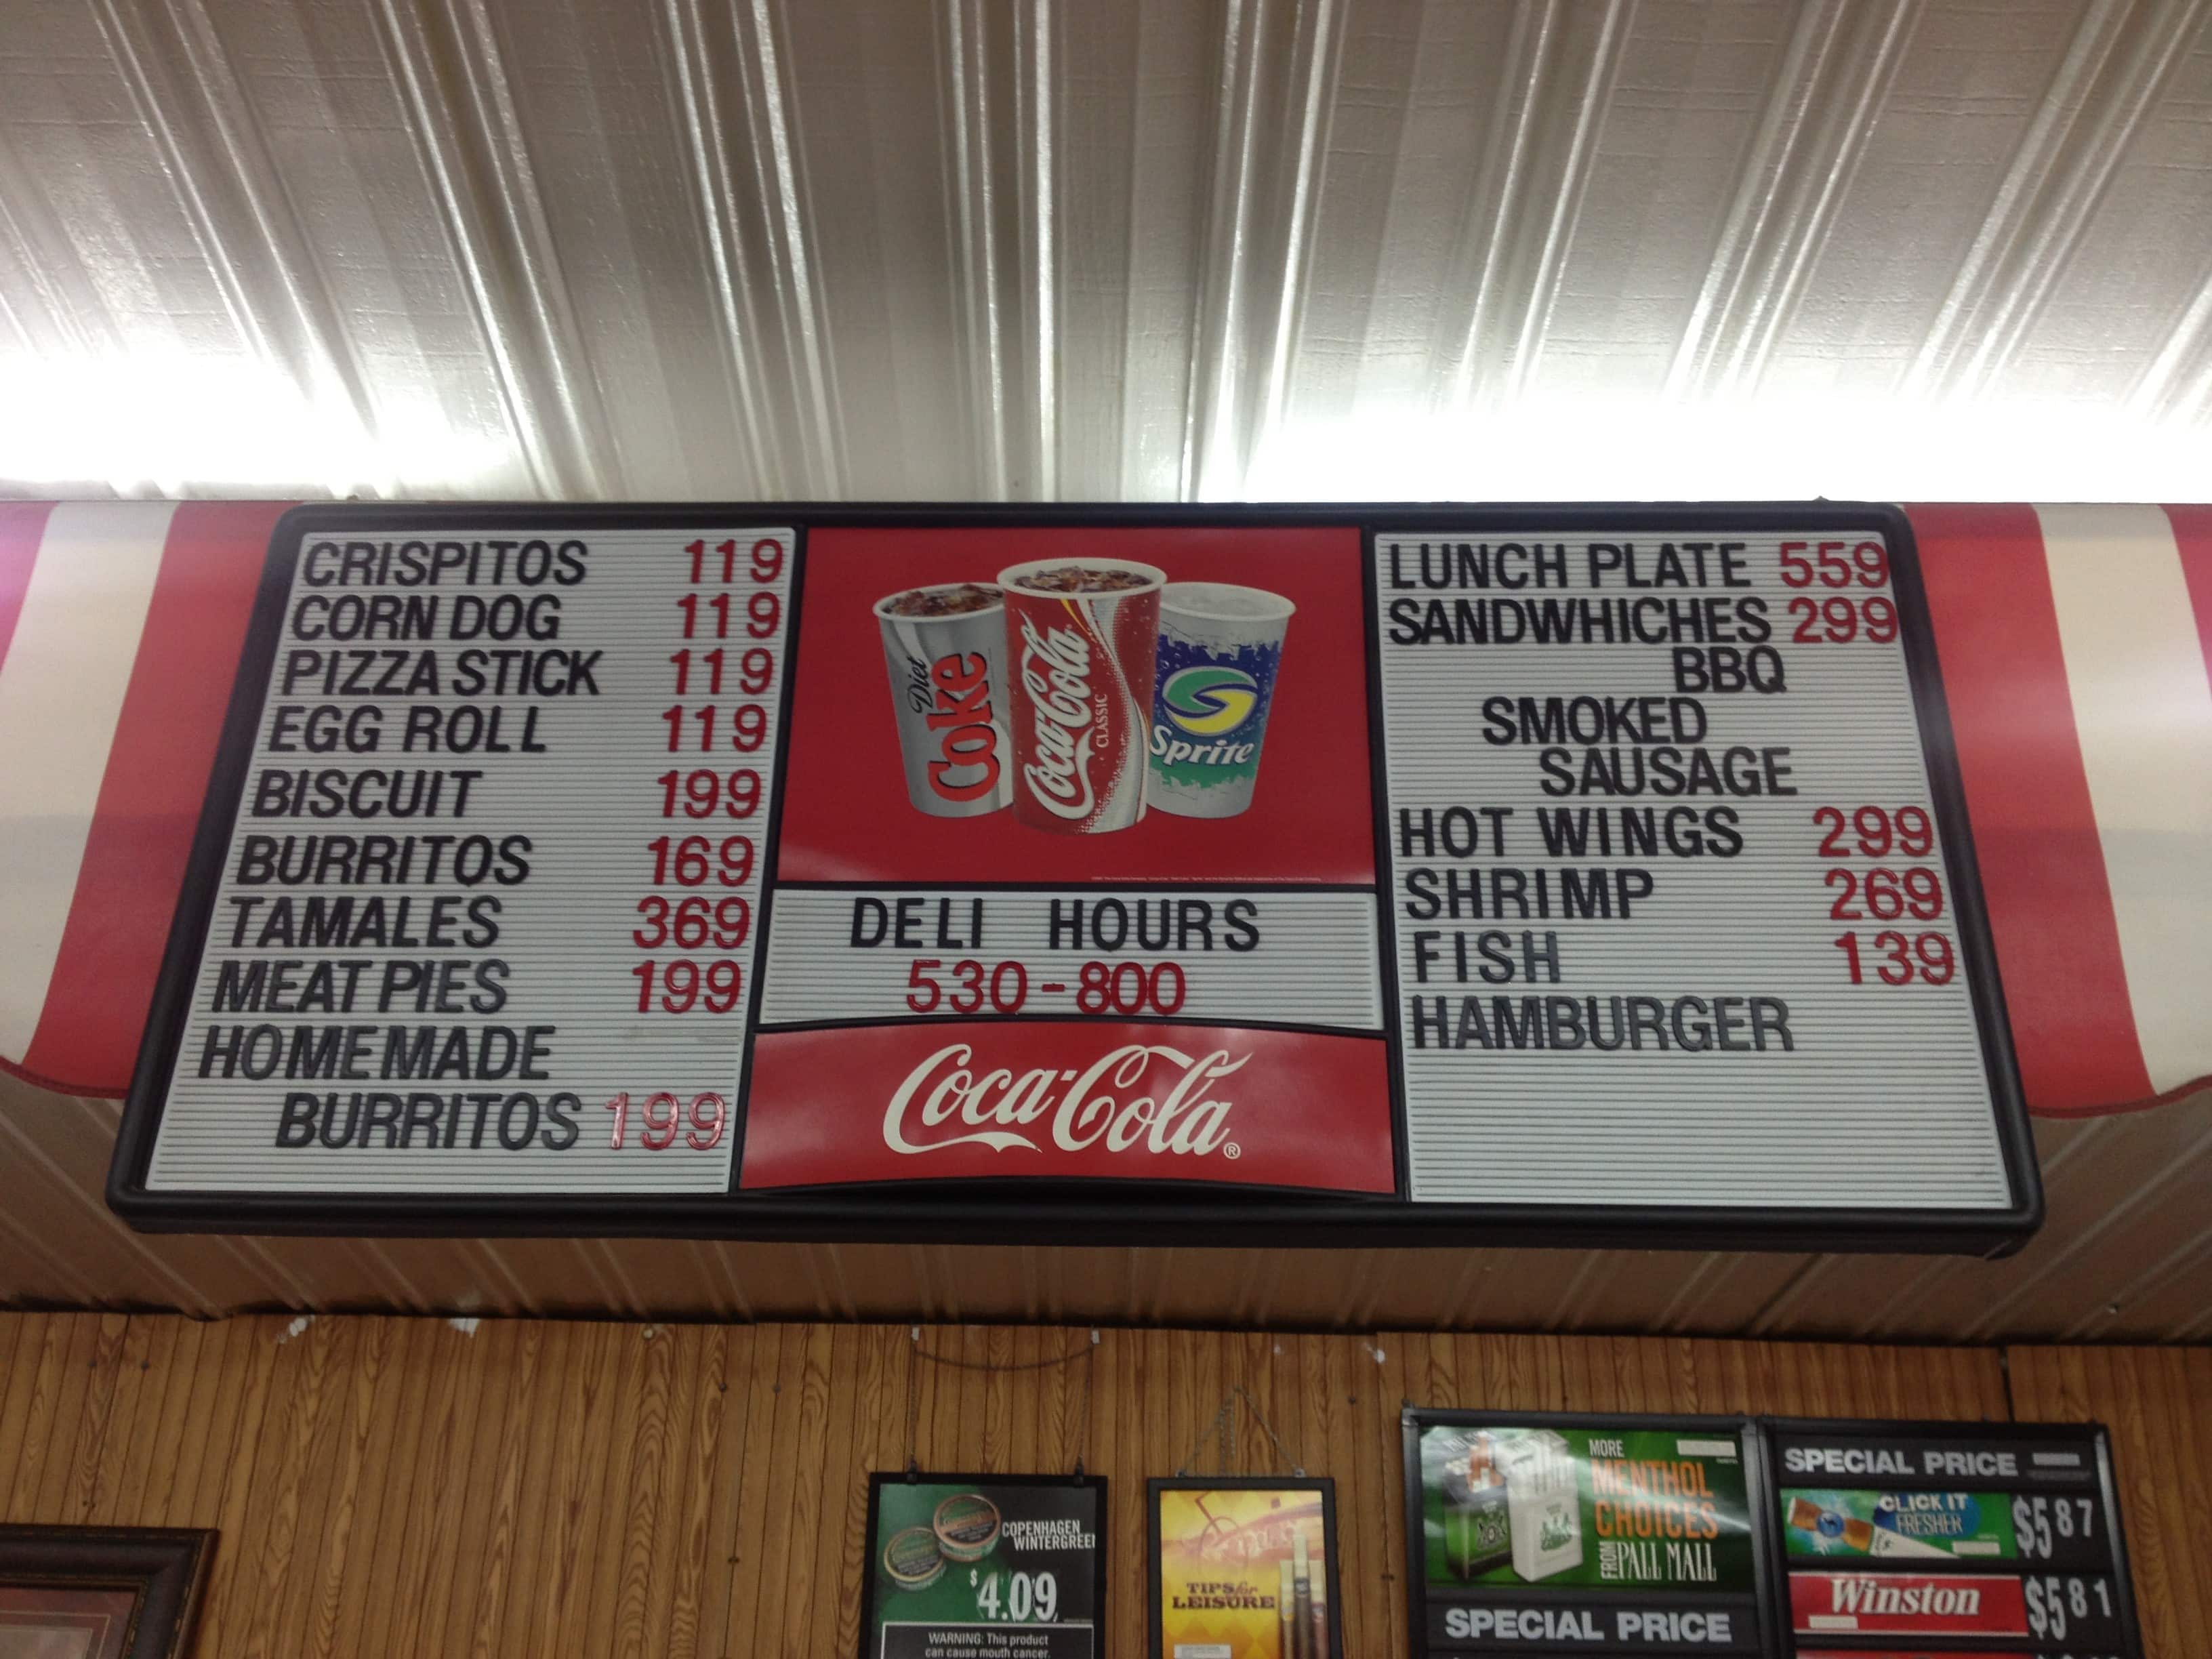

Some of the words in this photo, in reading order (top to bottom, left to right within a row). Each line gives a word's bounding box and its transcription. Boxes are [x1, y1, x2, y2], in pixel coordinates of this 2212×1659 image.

[303, 539, 588, 587] CRISPITOS
[684, 539, 783, 584] 119
[1389, 541, 1568, 590] LUNCH
[1589, 543, 1752, 588] PLATE
[1780, 541, 1889, 588] 559
[292, 594, 438, 640] CORN
[448, 594, 561, 640] DOG
[678, 592, 781, 639] 119
[1388, 596, 1773, 645] SANDWHICHES
[1786, 595, 1898, 644] 299
[281, 649, 439, 696] PIZZA
[452, 649, 602, 696] STICK
[670, 648, 774, 695] 119
[907, 655, 933, 714] Diet
[1673, 645, 1787, 693] BBQ
[269, 704, 382, 753] EGG
[403, 704, 547, 753] ROLL
[662, 704, 767, 752] 119
[925, 651, 1001, 802] Coke
[1018, 609, 1095, 820] Coca-Cola
[1094, 693, 1109, 748] CLASSIC
[1482, 696, 1708, 746] SMOKED
[1149, 724, 1254, 766] Sprite
[251, 769, 482, 818] BISCUIT
[657, 769, 761, 819] 199
[1539, 746, 1798, 798] SAUSAGE
[1399, 806, 1515, 859] HOT
[1538, 806, 1744, 858] WINGS
[1811, 806, 1934, 858] 299
[235, 835, 533, 887] BURRITOS
[649, 835, 754, 886] 169
[1405, 868, 1654, 920] SHRIMP
[1823, 866, 1944, 921] 269
[228, 895, 501, 949] TAMALES
[633, 895, 751, 949] 369
[851, 897, 983, 948] DELI
[1048, 898, 1260, 951] HOURS
[1412, 929, 1561, 985] FISH
[1833, 930, 1956, 986] 139
[211, 958, 373, 1014] MEAT
[378, 958, 511, 1014] PIES
[631, 958, 741, 1014] 199
[906, 959, 1187, 1015] 530-800
[1412, 994, 1796, 1052] HAMBURGER
[198, 1024, 556, 1081] HOMEMADE
[275, 1091, 582, 1151] BURRITOS
[605, 1091, 726, 1151] 199
[882, 1043, 1253, 1155] Coca-Cola
[1589, 1439, 1624, 1458] MORE
[1784, 1448, 1915, 1474] SPECIAL
[1923, 1452, 2018, 1477] PRICE
[1591, 1458, 1715, 1497] MENTHOL
[1594, 1500, 1719, 1540] CHOICES
[1879, 1494, 1944, 1512] CLICK
[1946, 1493, 1968, 1511] IT
[1002, 1520, 1080, 1538] COPENHAGEN
[1599, 1541, 1618, 1580] FROM
[1617, 1541, 1662, 1580] PALL
[1665, 1542, 1717, 1581] MALL
[1172, 1596, 1275, 1610] LEISURE
[1187, 1582, 1234, 1593] TIPS
[1829, 1578, 1981, 1616] Winston
[928, 1632, 983, 1645] WARNING:
[986, 1633, 1008, 1645] This
[1010, 1634, 1048, 1647] product
[1445, 1608, 1605, 1639] SPECIAL
[1618, 1611, 1733, 1642] PRICE
[925, 1647, 943, 1658] can
[946, 1647, 977, 1658] cause
[979, 1647, 1010, 1658] mouth
